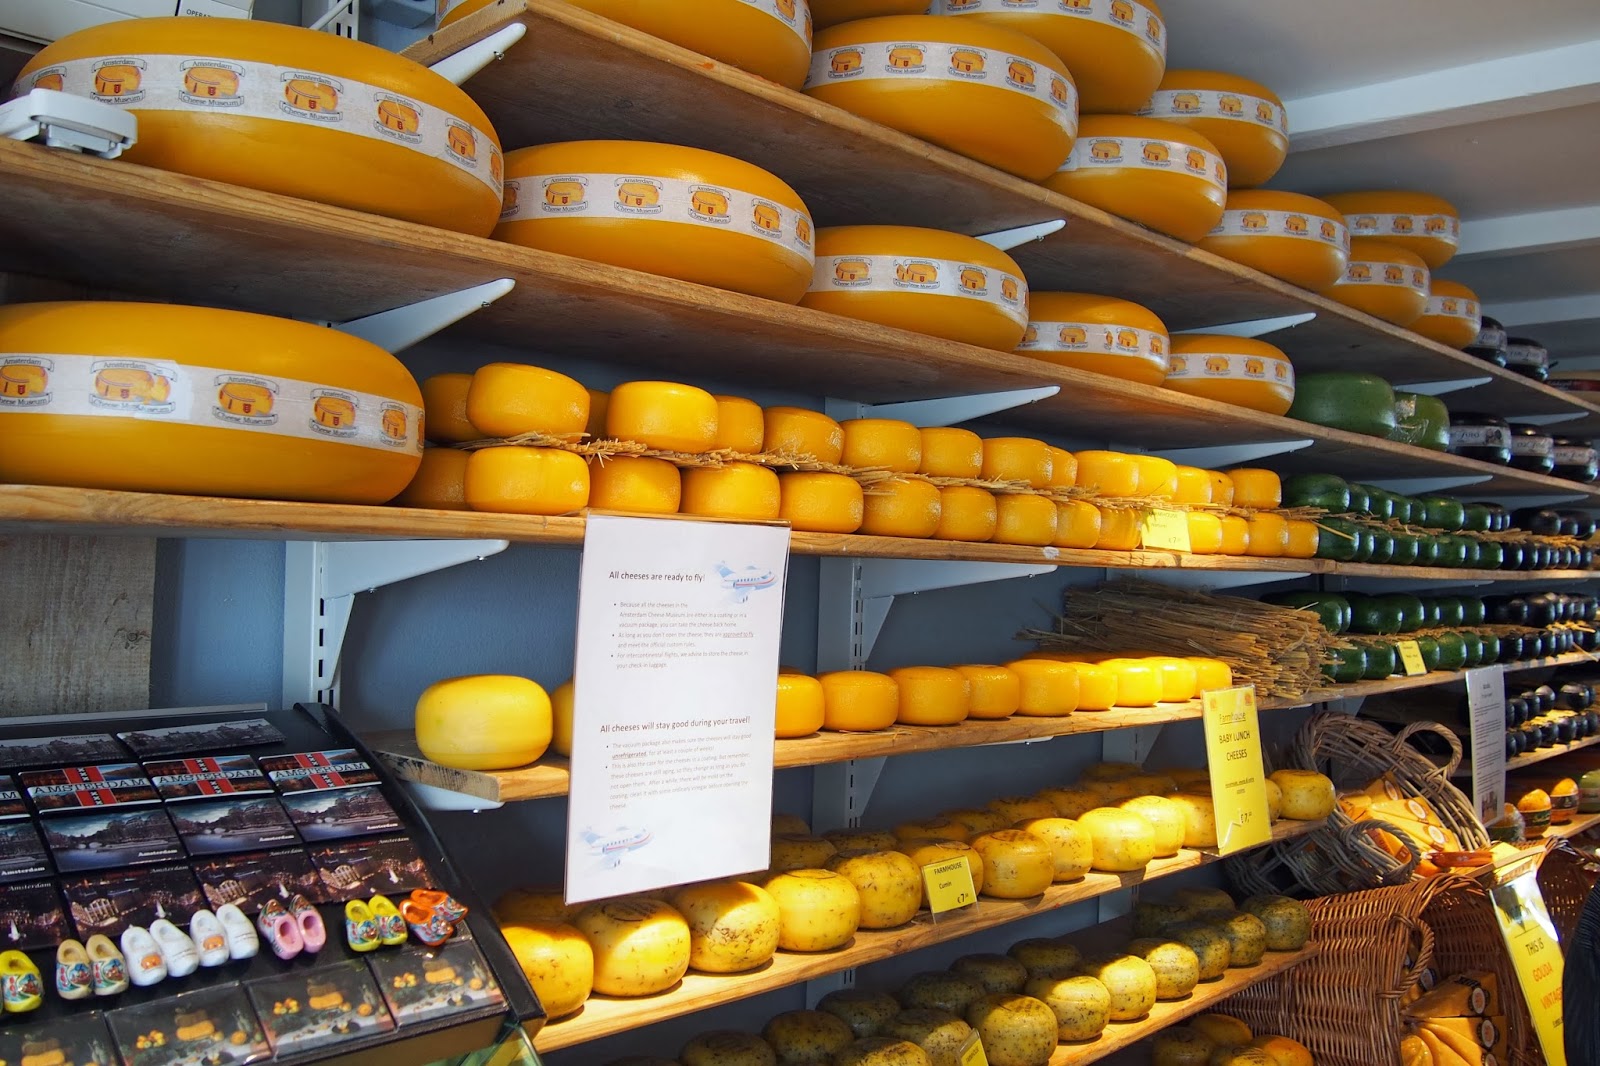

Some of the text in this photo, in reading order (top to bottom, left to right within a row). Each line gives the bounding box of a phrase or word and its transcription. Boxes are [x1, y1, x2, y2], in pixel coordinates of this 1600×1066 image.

[187, 9, 212, 17] OPERA
[192, 61, 233, 70] Amsterdam
[293, 73, 332, 86] Amsterdam
[93, 96, 113, 104] Cheese
[182, 96, 207, 105] Cheese
[283, 107, 338, 120] Cheese Museum
[4, 358, 42, 366] Amsterdam
[103, 362, 147, 370] Amsterdam
[228, 376, 268, 387] Amsterdam
[217, 410, 273, 425] Cheese Museum
[609, 570, 706, 584] All cheeses are ready to fly!
[1219, 712, 1247, 723] Farmhouse
[600, 715, 751, 733] All cheeses will stay good during your travel!
[1219, 730, 1251, 743] BABY LUNCH
[1227, 749, 1248, 761] CHEESES
[274, 762, 366, 779] AMSTERDAM
[160, 769, 259, 784] AMSTERDAM
[34, 777, 146, 795] AMSTERDAM
[366, 823, 399, 831] Amsterdam
[138, 850, 178, 858] Amsterdam
[1, 866, 46, 876] Amsterdam
[151, 865, 189, 874] Amsterdam
[933, 862, 963, 875] FARMHOUSE
[9, 882, 52, 892] Amsterdam
[938, 881, 953, 889] Cumin
[1525, 941, 1538, 957] THIS
[1532, 961, 1553, 983] GOUDA
